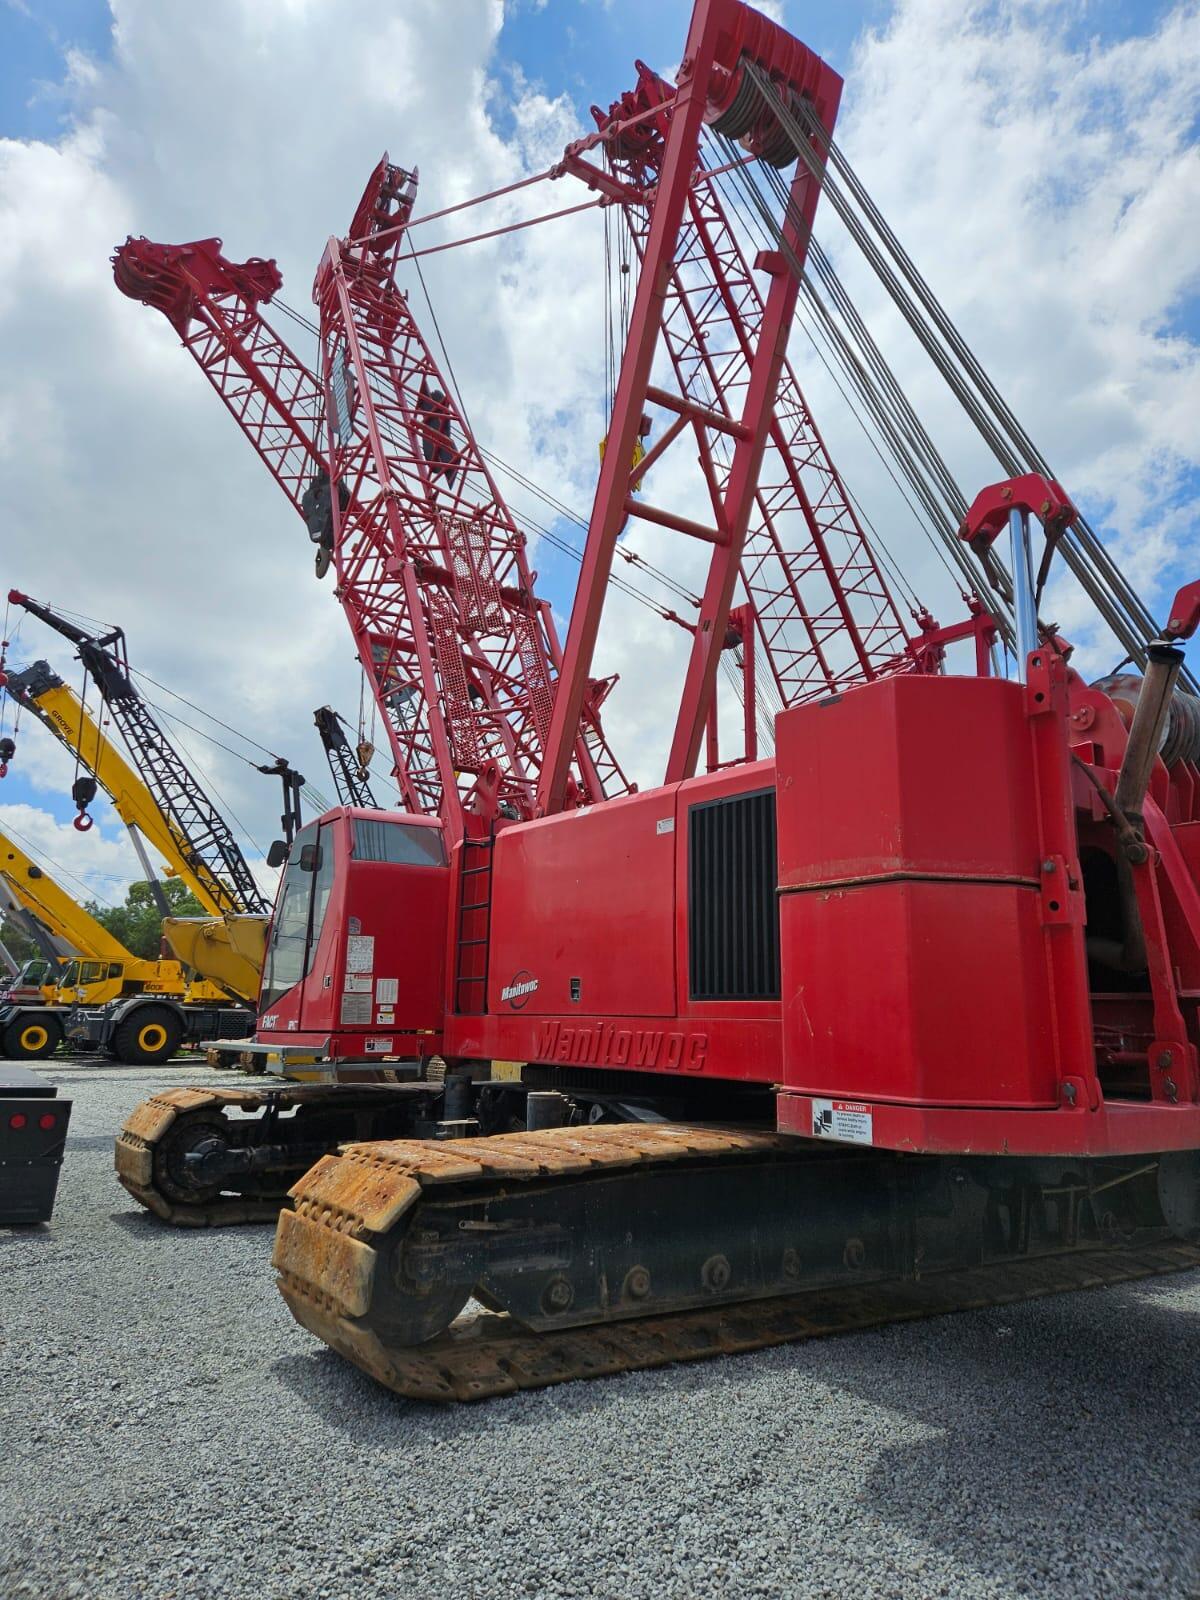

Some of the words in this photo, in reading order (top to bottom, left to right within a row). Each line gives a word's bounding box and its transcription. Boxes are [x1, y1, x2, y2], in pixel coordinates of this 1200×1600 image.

[52, 710, 74, 735] GROVE
[501, 979, 539, 1001] Manitowoc
[535, 1021, 709, 1071] Manitowoc
[845, 1104, 867, 1112] DANGER
